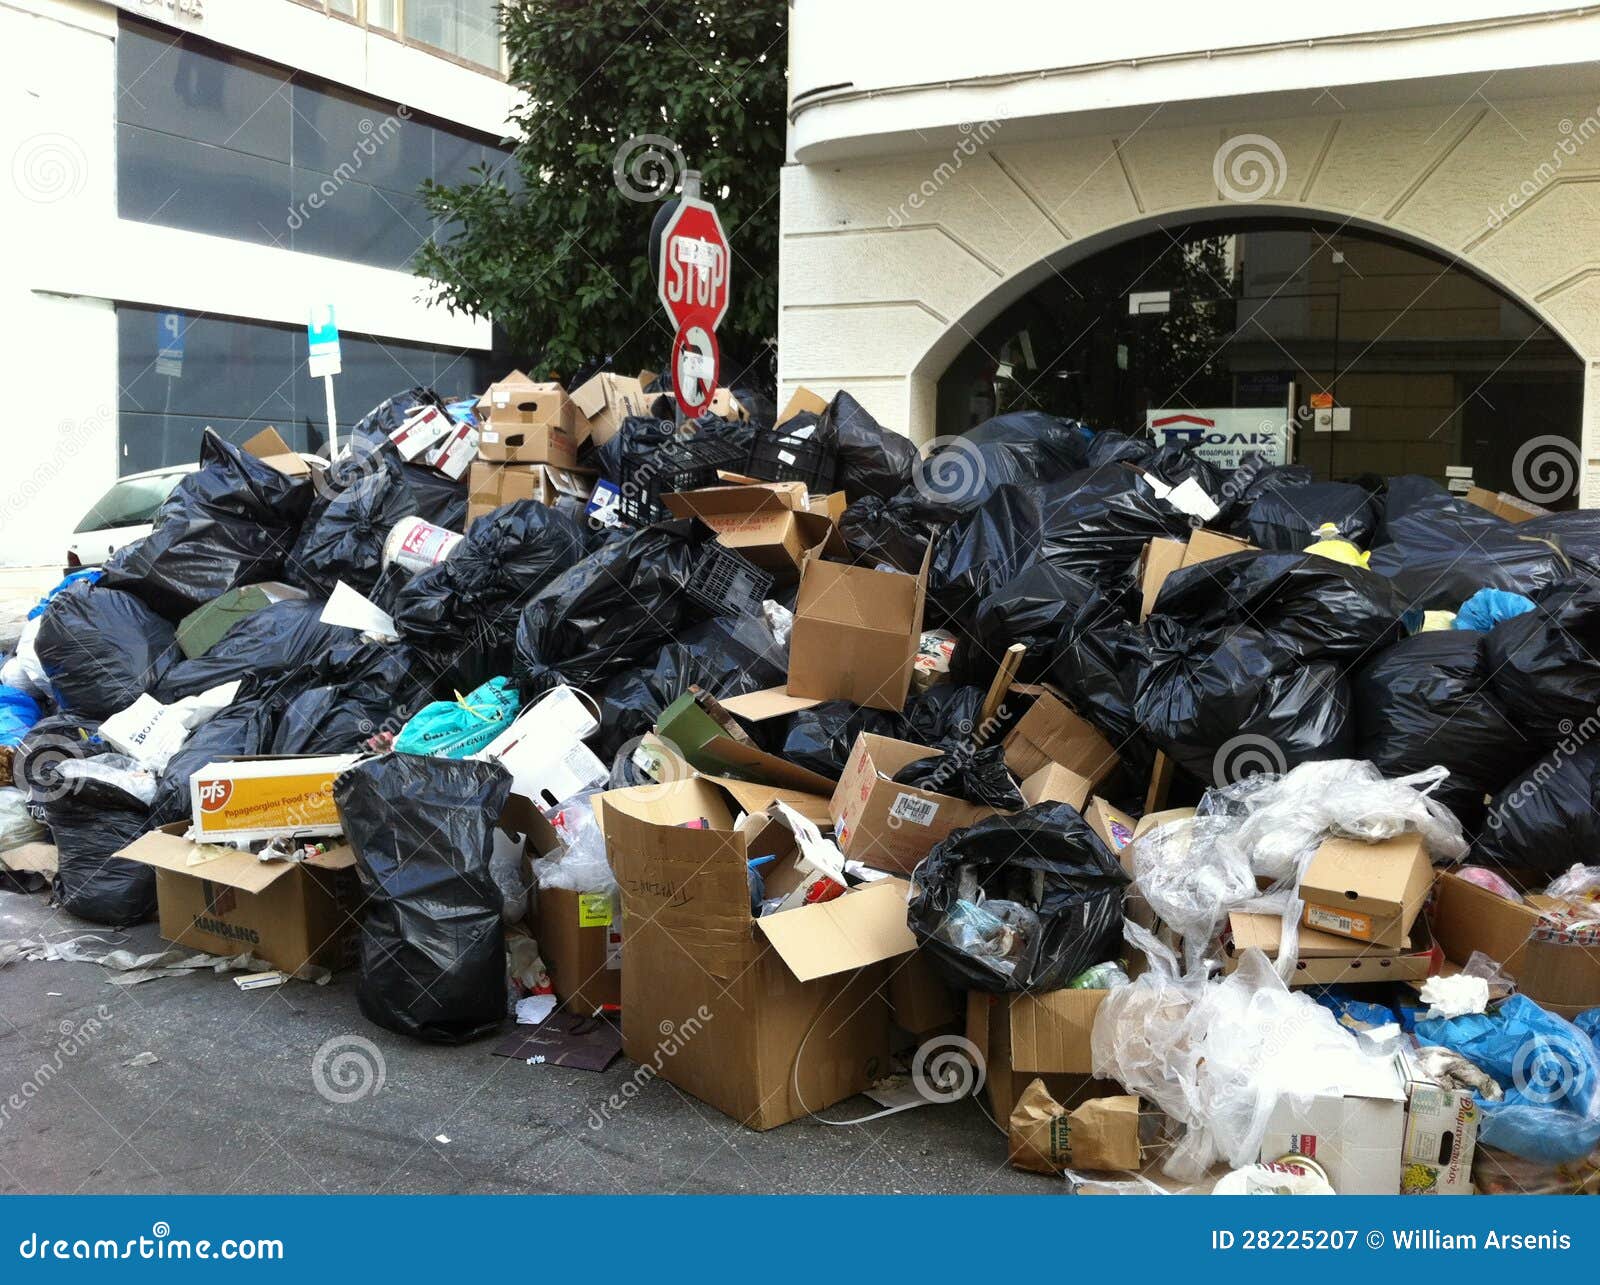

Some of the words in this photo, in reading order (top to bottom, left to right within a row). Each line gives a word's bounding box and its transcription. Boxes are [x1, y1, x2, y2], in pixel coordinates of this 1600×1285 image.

[668, 235, 724, 308] STOP
[200, 780, 226, 804] pfs
[224, 799, 280, 819] Papageorgiou
[282, 793, 303, 806] Food
[193, 914, 260, 944] HANDLING
[1059, 1116, 1073, 1151] erland
